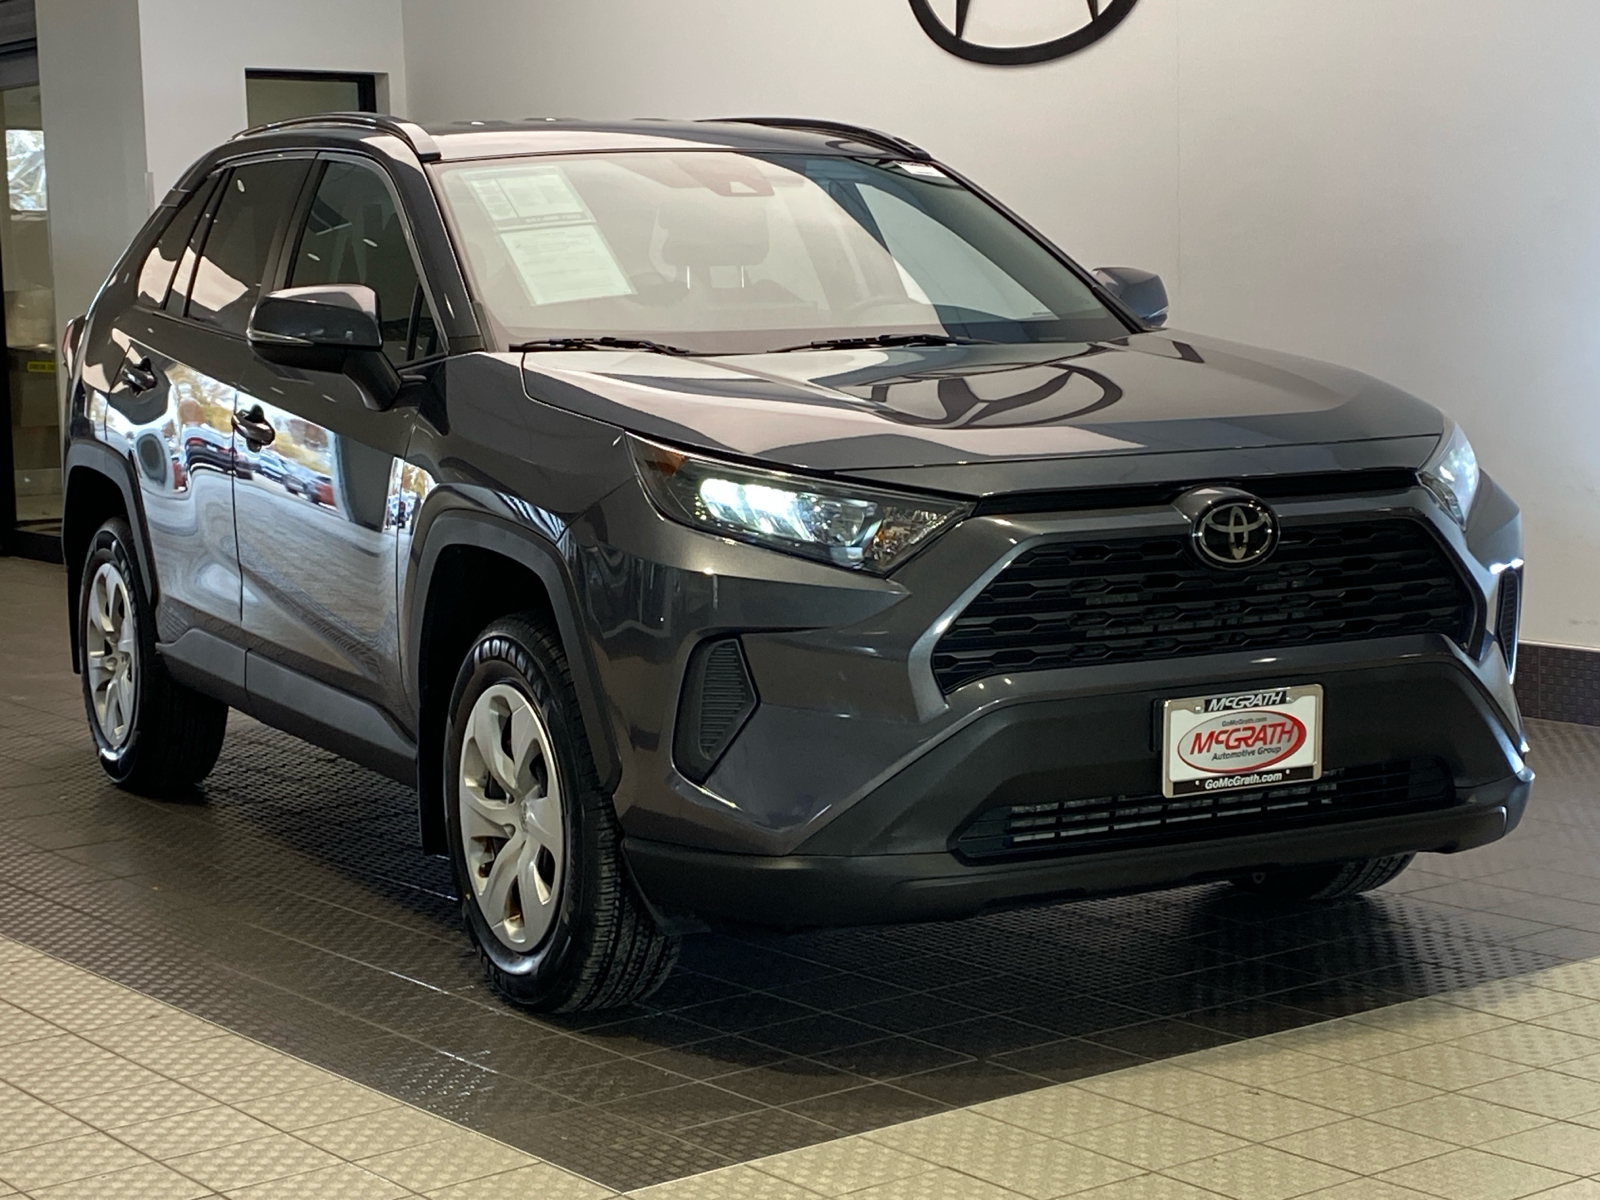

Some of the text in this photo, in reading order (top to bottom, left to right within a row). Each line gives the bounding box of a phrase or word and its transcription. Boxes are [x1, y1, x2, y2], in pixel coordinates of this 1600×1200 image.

[1211, 746, 1282, 761] Automotive Group
[1205, 773, 1282, 789] GoMcGrath.com
